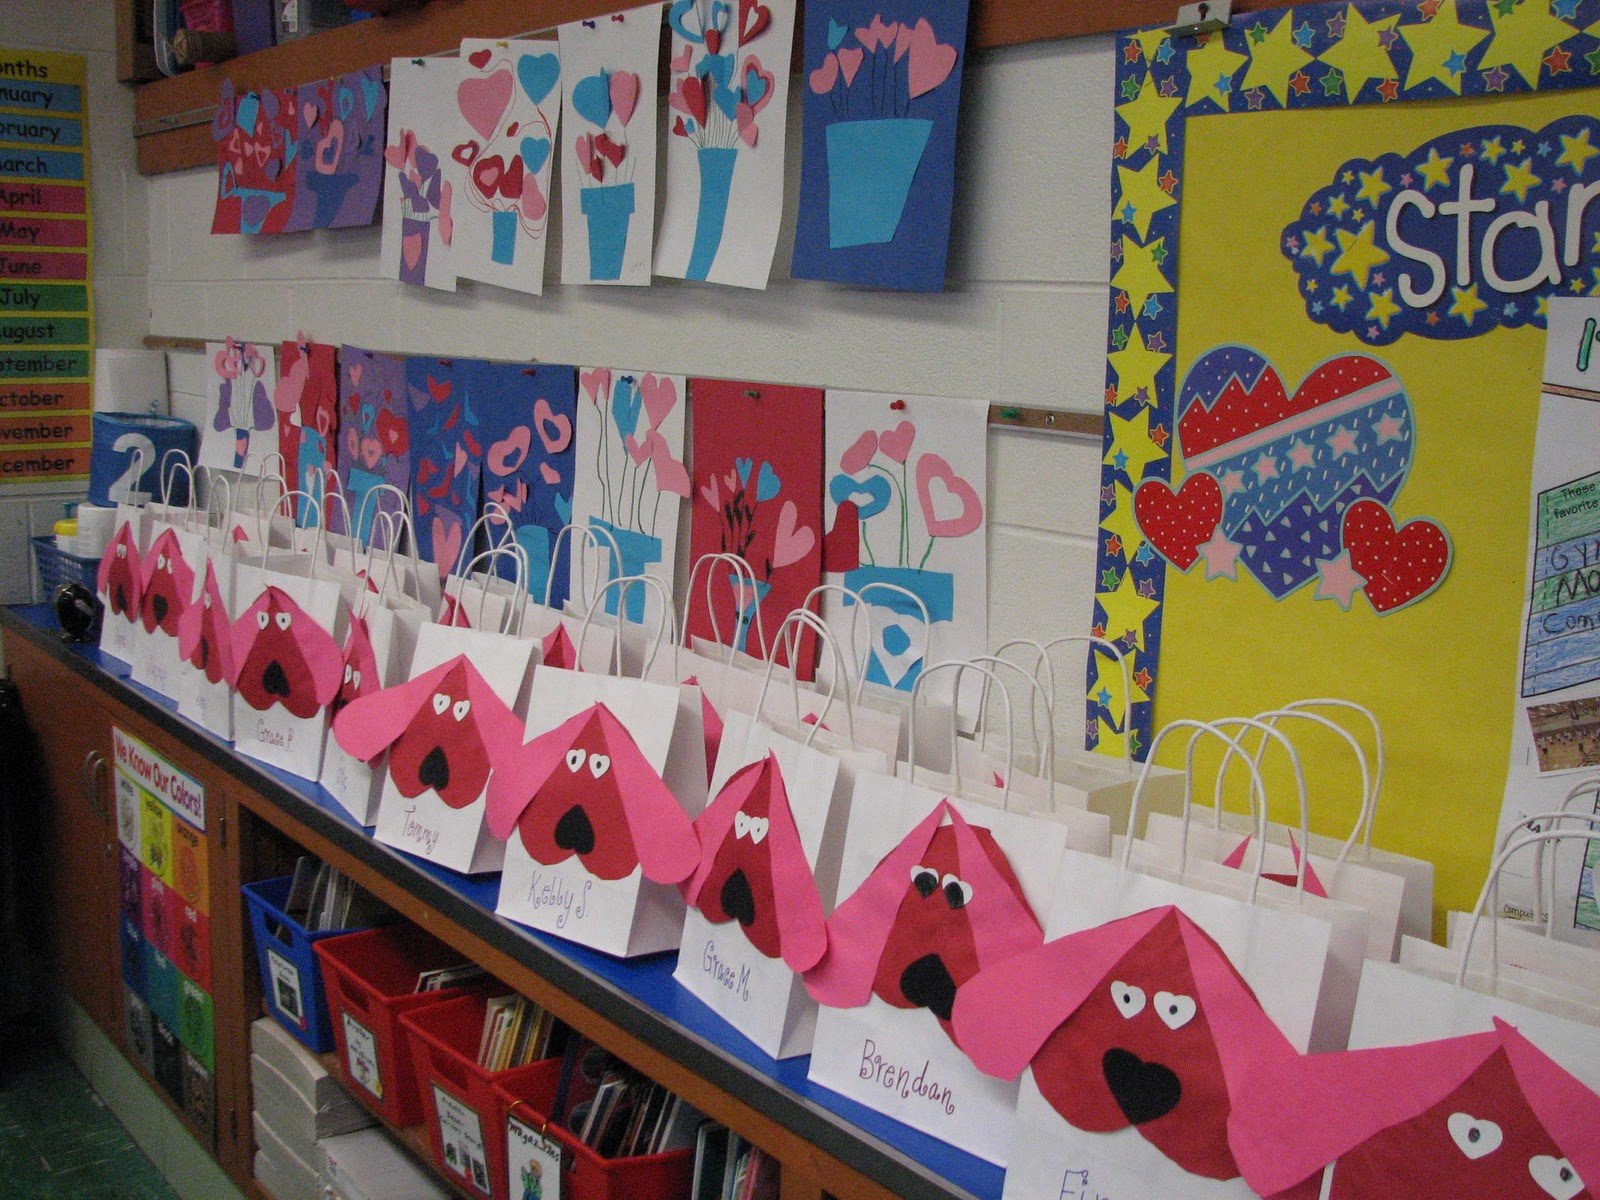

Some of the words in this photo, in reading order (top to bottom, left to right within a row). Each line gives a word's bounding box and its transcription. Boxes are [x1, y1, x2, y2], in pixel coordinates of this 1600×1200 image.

[0, 156, 47, 174] arch
[0, 221, 40, 242] May
[1386, 164, 1600, 308] Star
[0, 288, 41, 310] July
[0, 324, 55, 344] ugust
[108, 433, 156, 505] 2
[1560, 481, 1597, 500] These
[1553, 498, 1600, 520] favorite
[1543, 612, 1600, 634] Com
[128, 744, 151, 781] Know
[153, 762, 169, 794] Our
[401, 804, 440, 855] Tommy
[1504, 903, 1549, 921] Computs
[703, 940, 736, 989] Grace
[859, 1039, 955, 1115] Brendan
